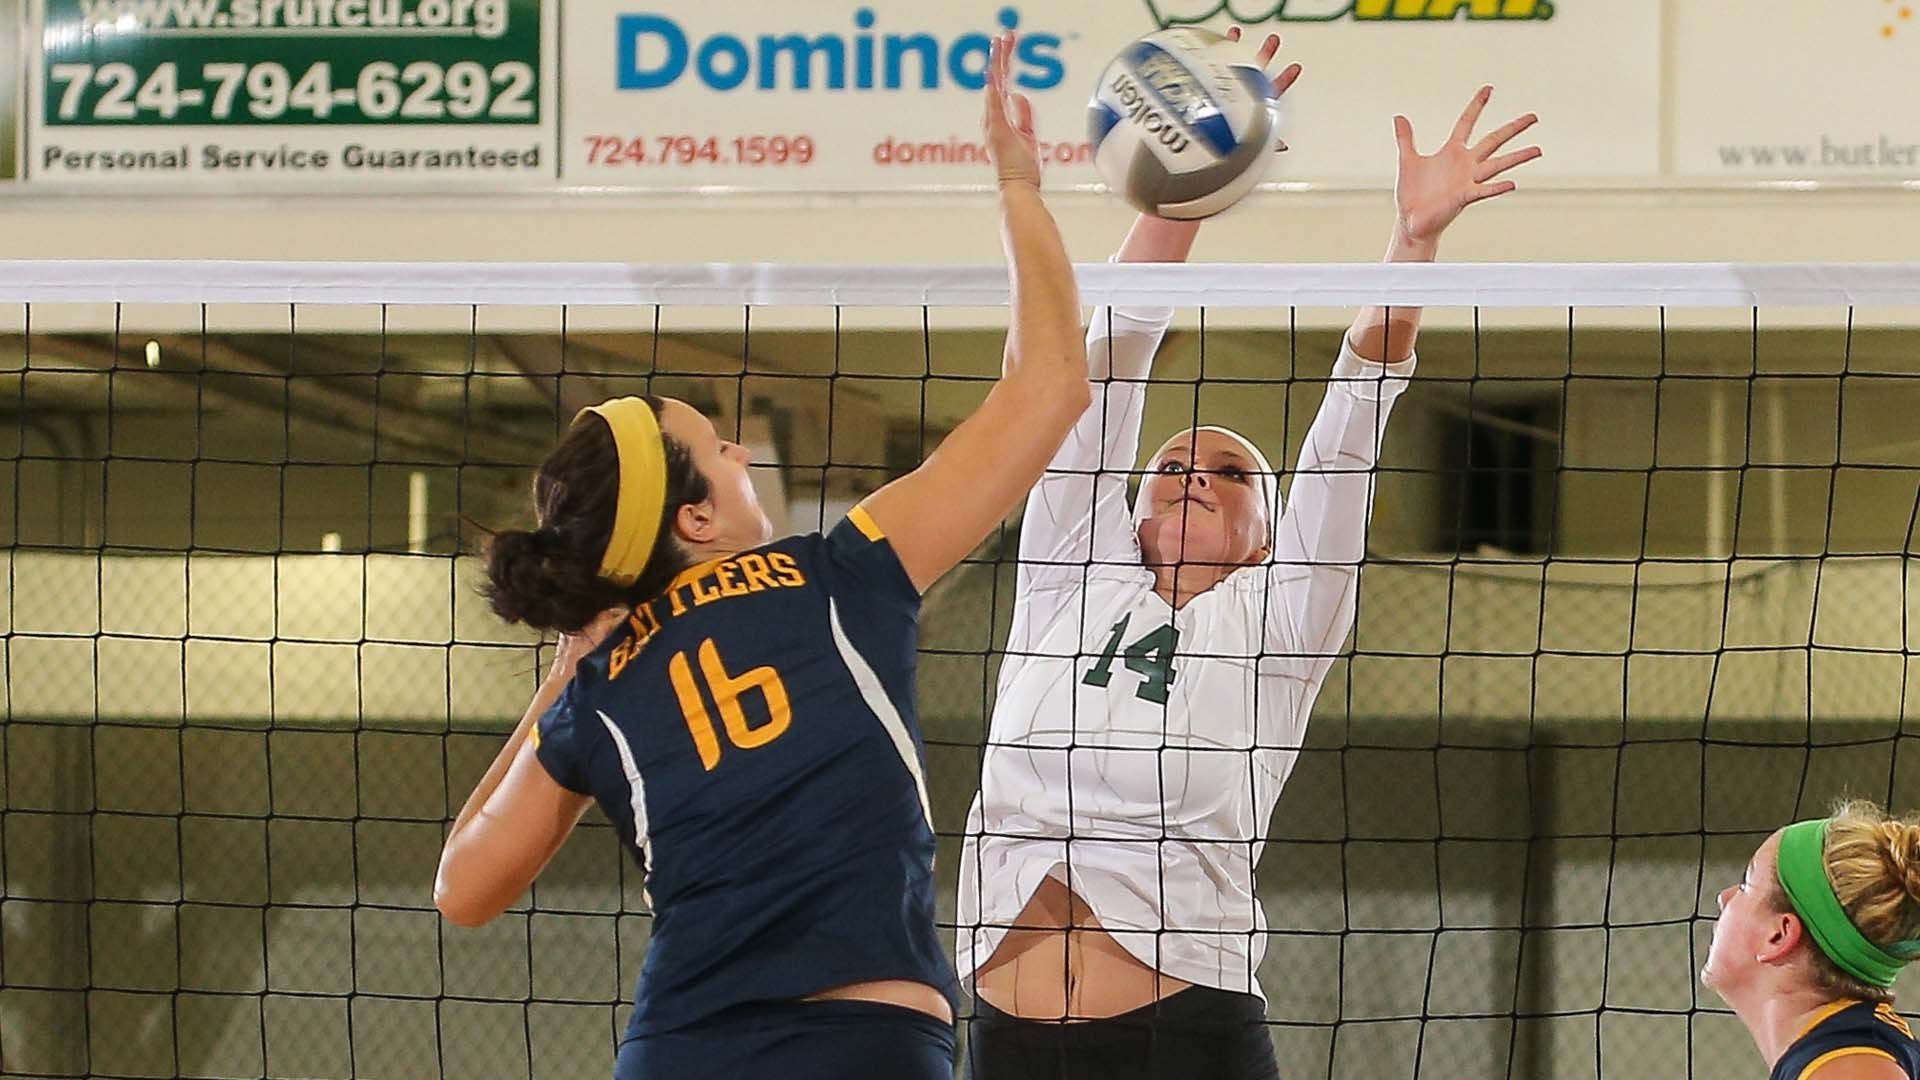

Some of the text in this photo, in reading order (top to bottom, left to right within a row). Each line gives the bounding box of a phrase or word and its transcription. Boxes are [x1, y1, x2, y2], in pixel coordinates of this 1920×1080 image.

[51, 61, 535, 118] 724-794-6292
[1111, 73, 1191, 154] molten
[43, 146, 540, 169] Personal Service Guaranteed
[585, 136, 813, 164] 724.794.1599
[1081, 611, 1180, 705] 14
[668, 637, 792, 771] 16
